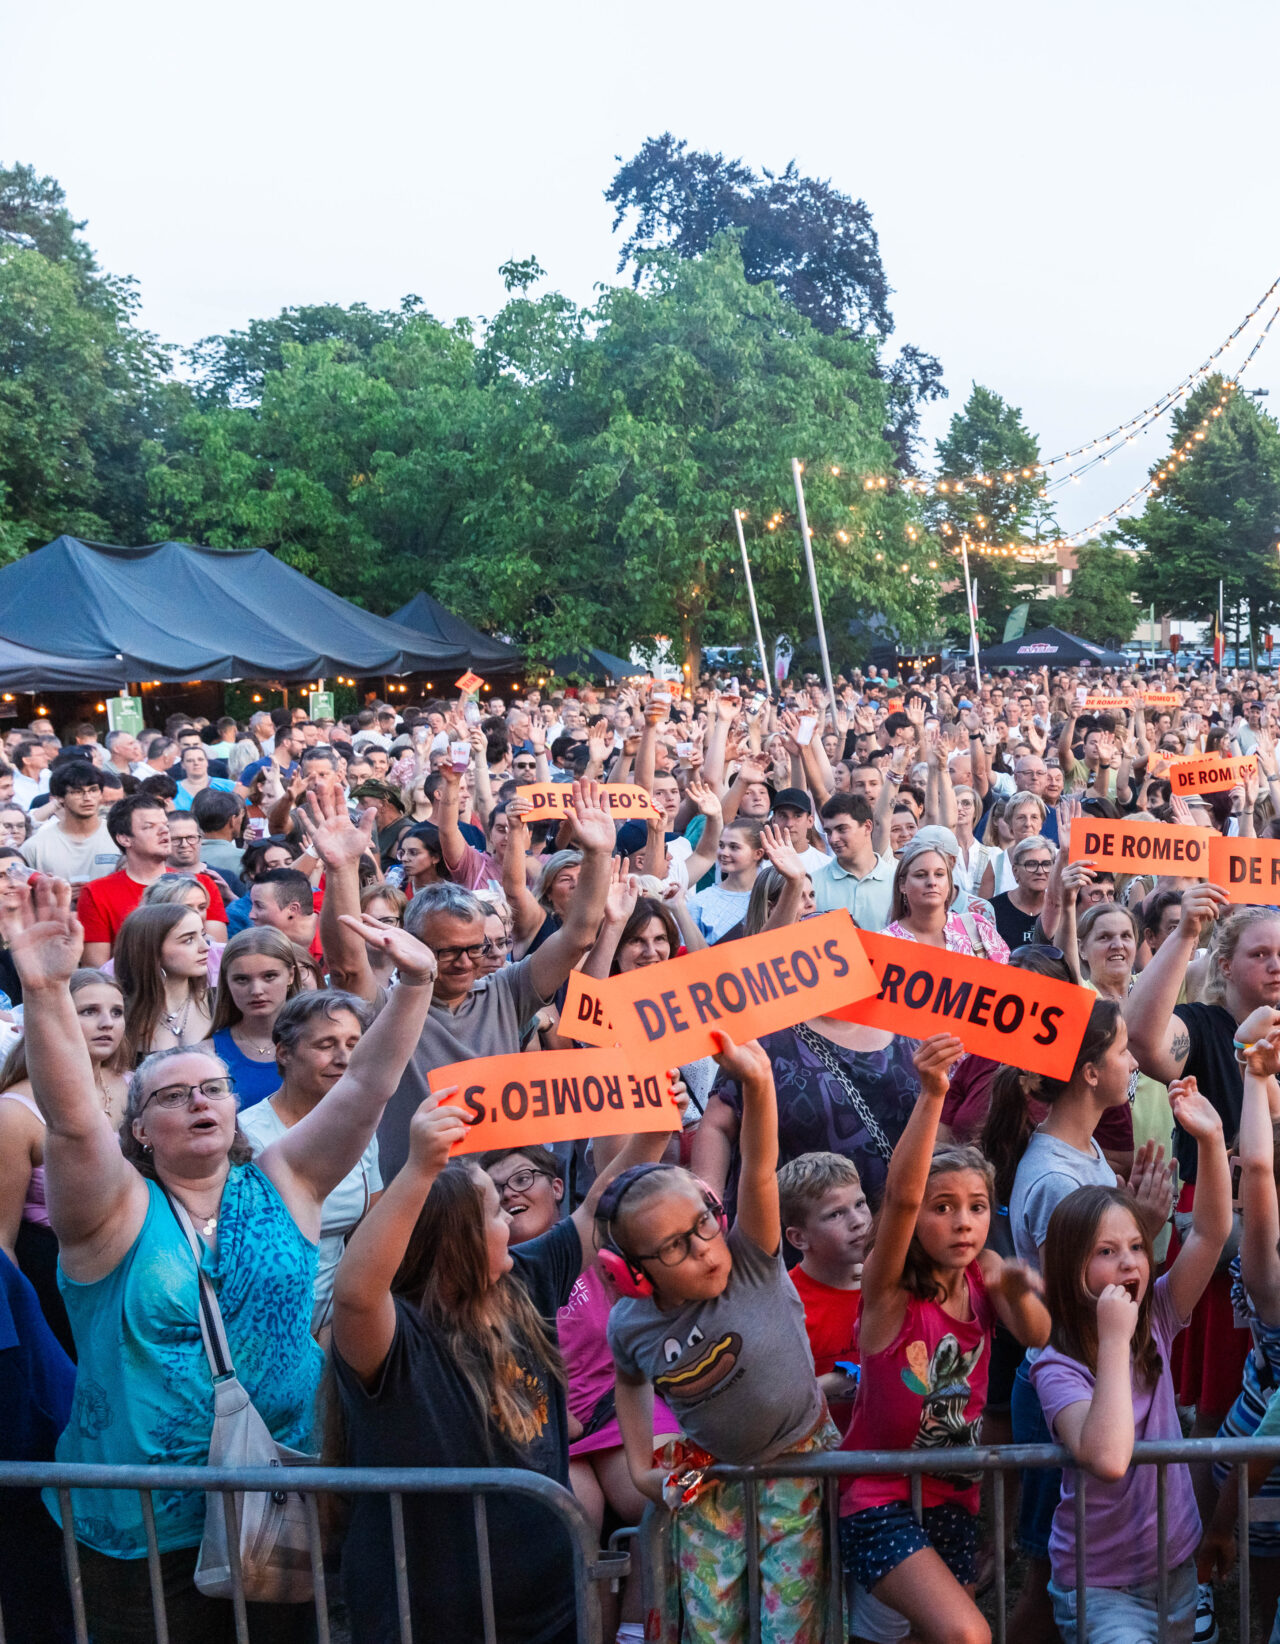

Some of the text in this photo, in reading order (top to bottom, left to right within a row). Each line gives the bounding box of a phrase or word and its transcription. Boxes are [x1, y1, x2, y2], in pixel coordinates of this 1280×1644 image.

[1178, 772, 1195, 787] DE
[532, 793, 648, 808] DE REO'S
[1084, 833, 1206, 861] DE ROMEO'
[1229, 855, 1262, 885] DE
[633, 939, 849, 1041] DE ROMEO'S
[877, 963, 1064, 1045] ROMEO'S
[578, 993, 603, 1026] DE
[464, 1074, 663, 1126] DE ROMEO'S
